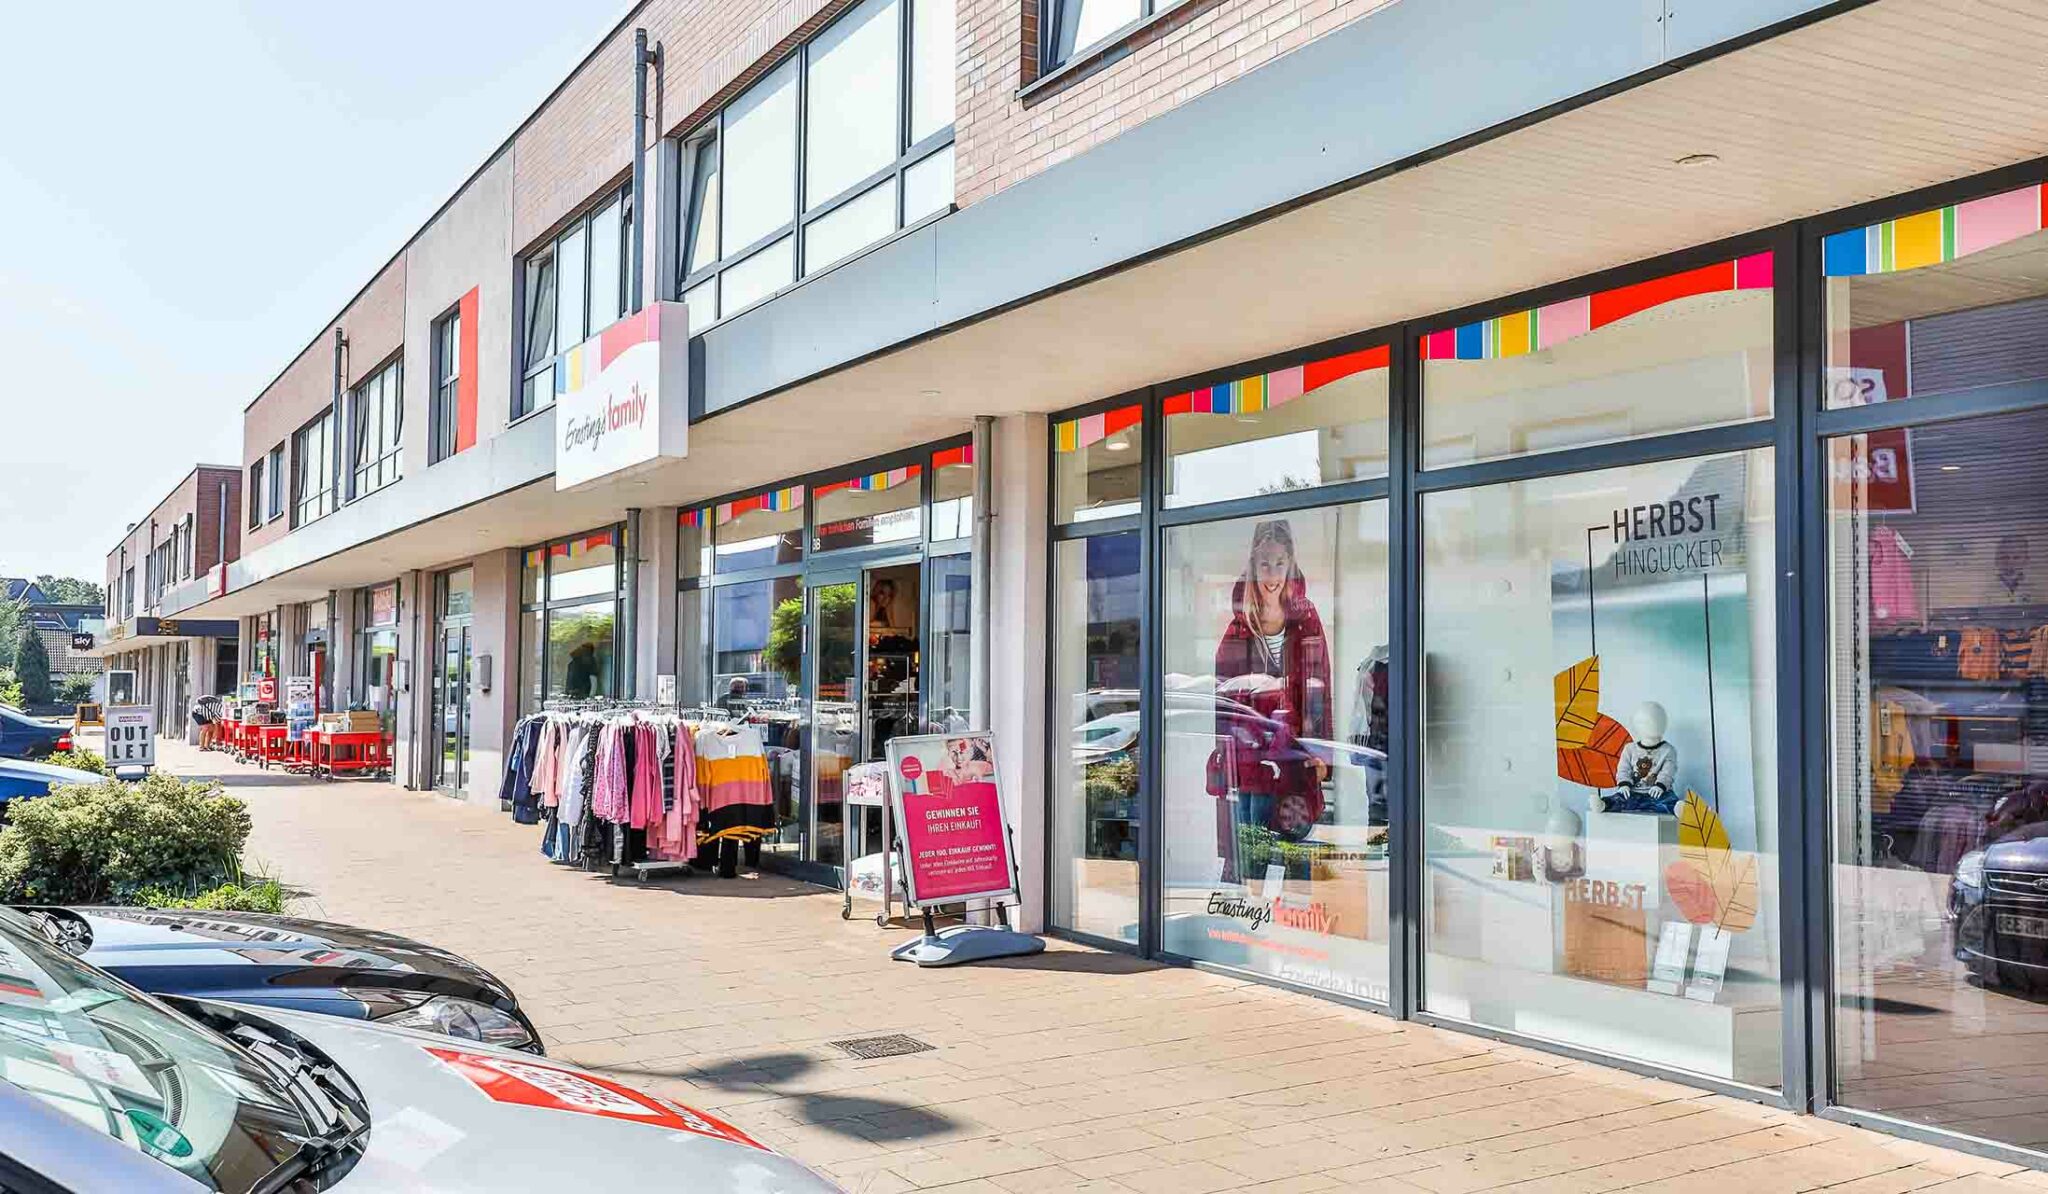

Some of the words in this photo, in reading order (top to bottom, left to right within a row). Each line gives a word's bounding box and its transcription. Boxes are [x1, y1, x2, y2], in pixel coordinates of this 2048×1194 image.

[608, 380, 647, 432] family
[1613, 494, 1720, 544] HERBST
[1615, 538, 1723, 579] HINGUCKER
[74, 636, 91, 646] sky
[110, 726, 148, 741] OUT
[112, 744, 148, 759] LET
[926, 807, 966, 820] GEWINNEN
[967, 806, 979, 816] SIE
[927, 823, 949, 833] IHREN
[918, 850, 936, 859] JEDER
[1565, 878, 1646, 910] HERBST
[1207, 891, 1271, 931] Ernsting's
